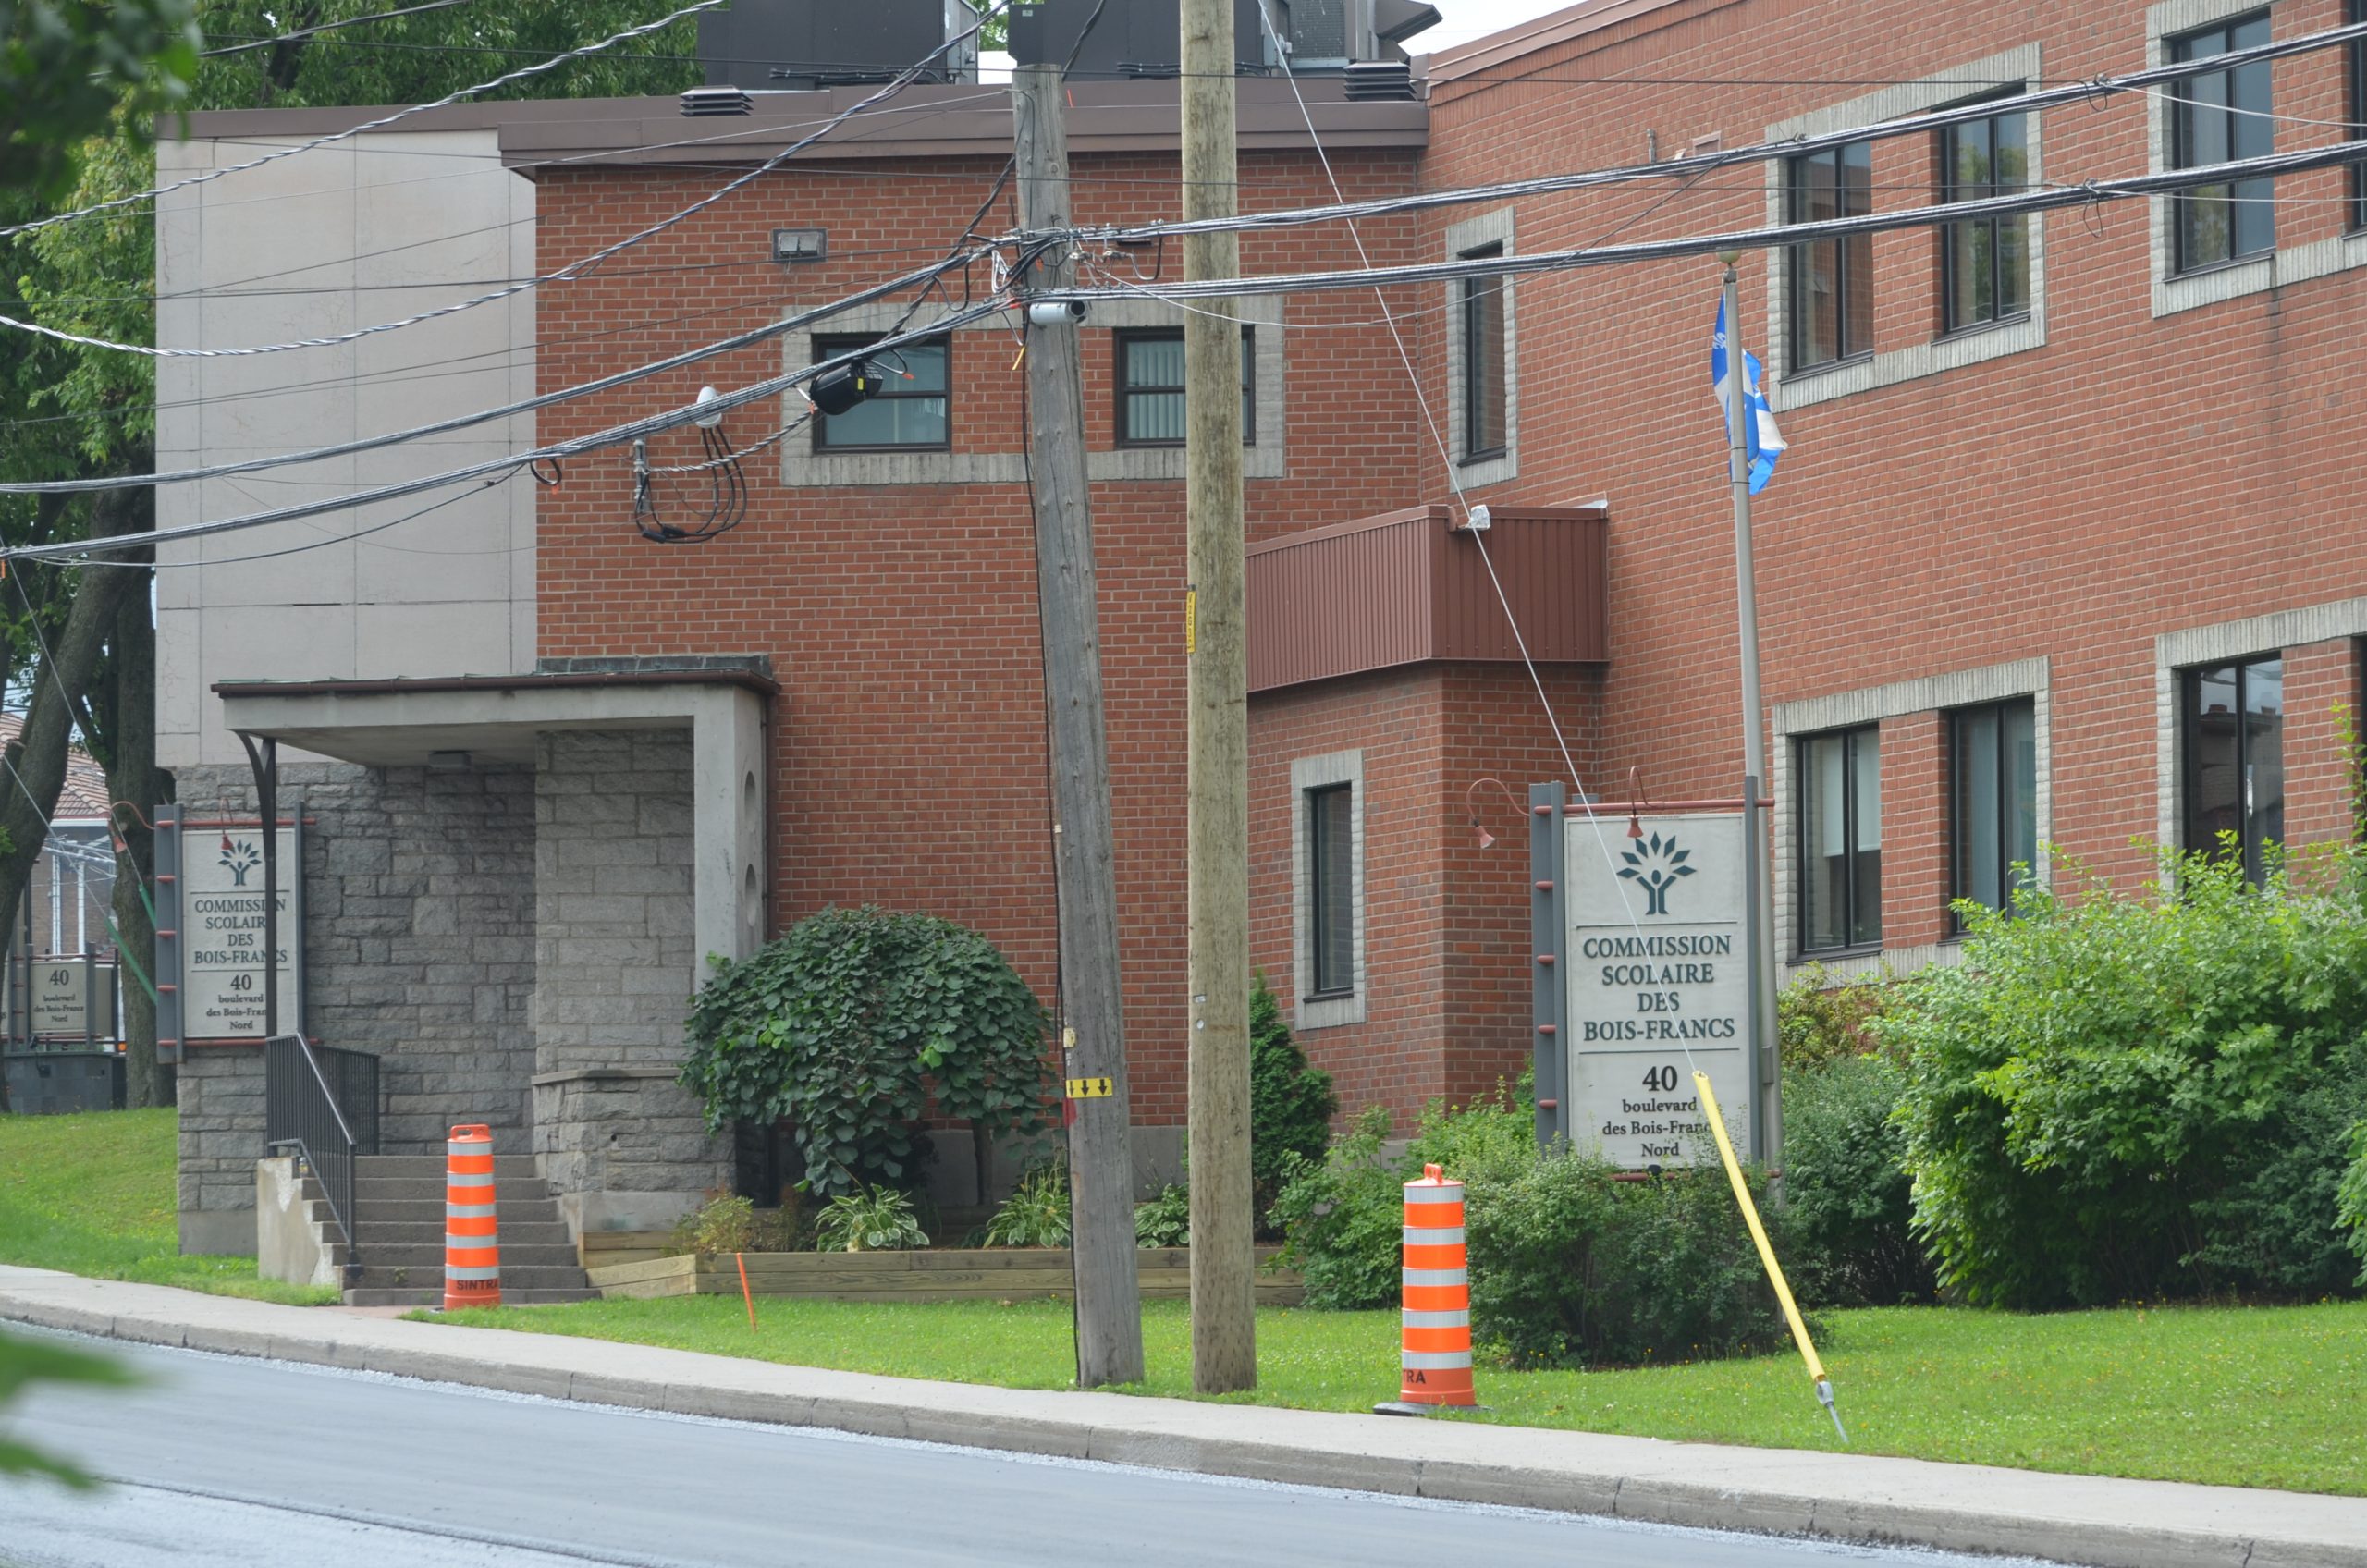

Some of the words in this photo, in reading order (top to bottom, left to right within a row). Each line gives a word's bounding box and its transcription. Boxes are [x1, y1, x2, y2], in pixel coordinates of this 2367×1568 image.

[195, 899, 286, 913] COMMISSIN
[205, 916, 266, 930] SCOLAIR
[227, 933, 254, 947] DES
[1583, 935, 1732, 959] COMMISSION
[49, 969, 69, 986] 40
[230, 974, 251, 990] 40
[1601, 963, 1715, 986] SCOLAIRE
[218, 994, 264, 1003] boulevard
[1637, 992, 1680, 1012] DES
[206, 1008, 221, 1017] des
[223, 1007, 267, 1017] Bois-Fran
[229, 1020, 253, 1031] Nord
[1583, 1018, 1735, 1042] BOIS-FRANCS
[1642, 1065, 1678, 1092] 40
[1622, 1096, 1698, 1113] boulevard
[1602, 1121, 1627, 1136] des
[1630, 1120, 1712, 1136] Bois-Franc
[1641, 1142, 1680, 1158] Nord
